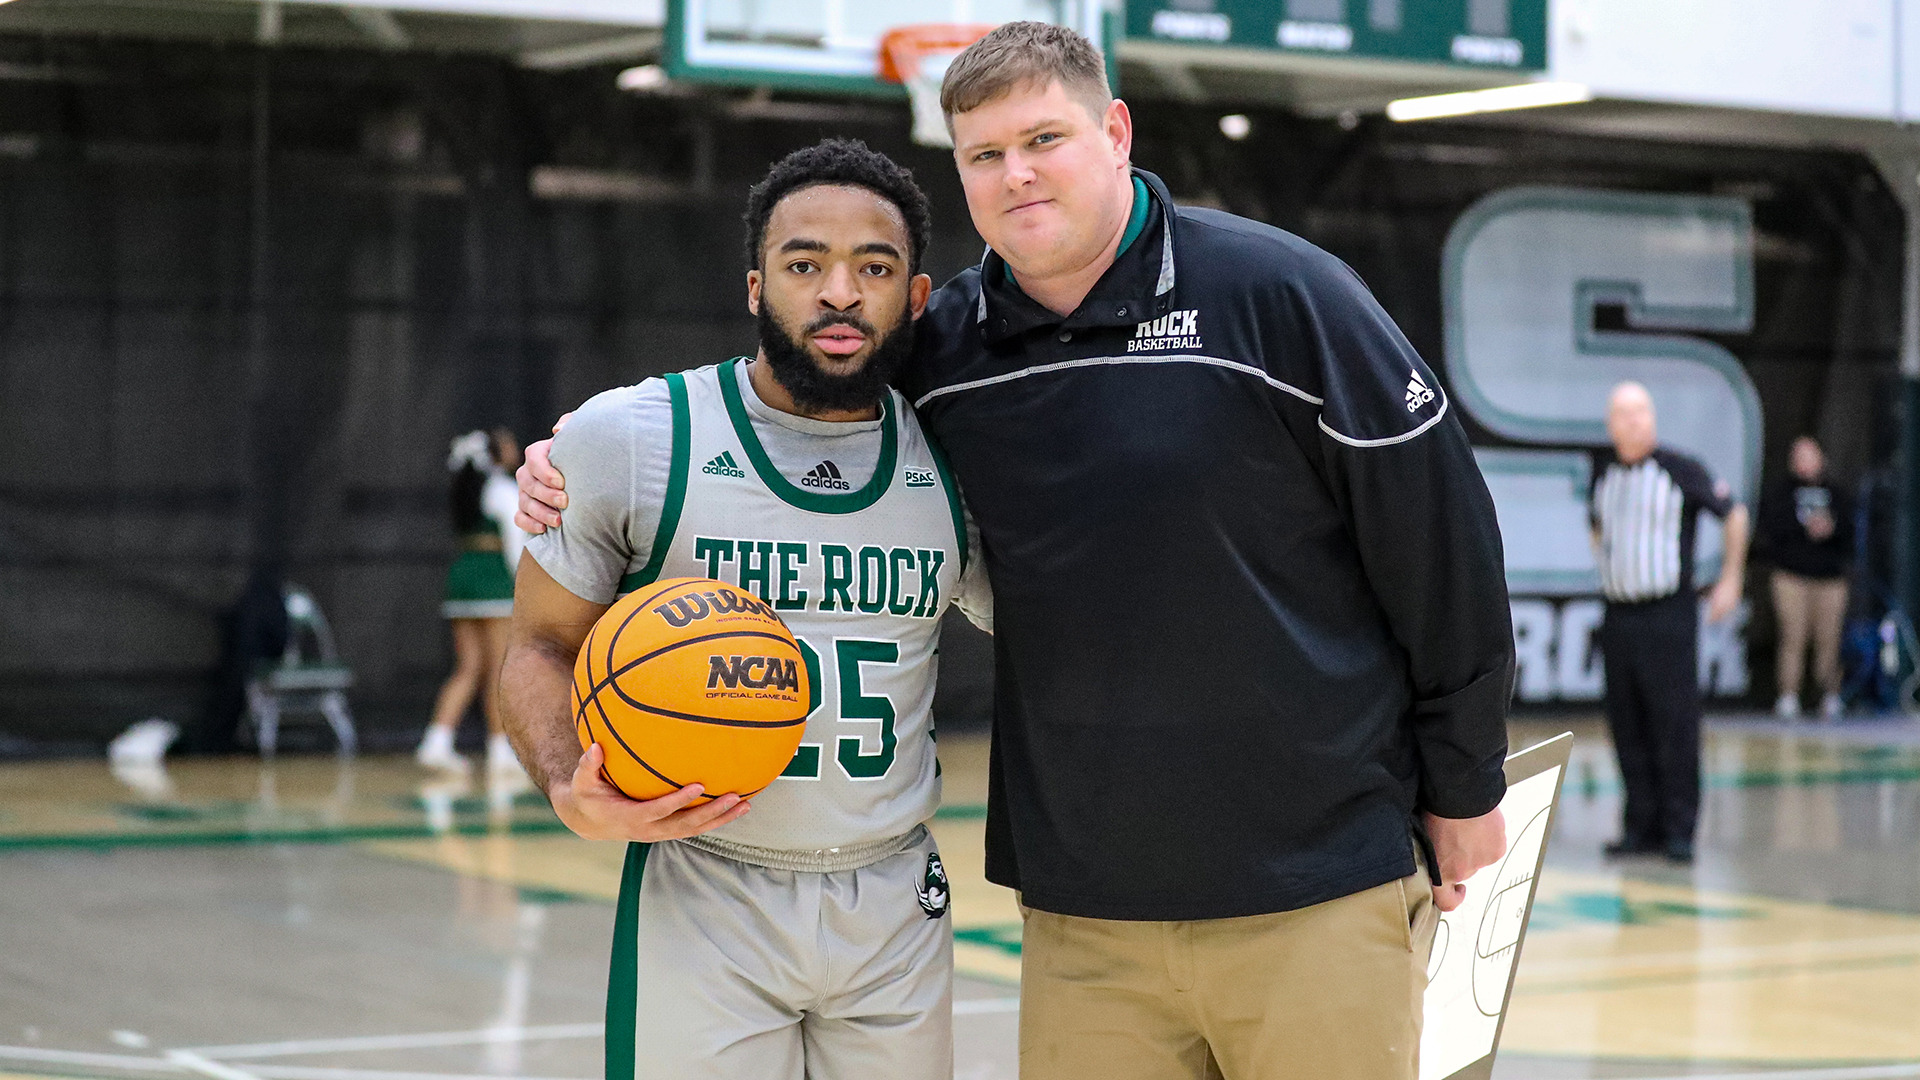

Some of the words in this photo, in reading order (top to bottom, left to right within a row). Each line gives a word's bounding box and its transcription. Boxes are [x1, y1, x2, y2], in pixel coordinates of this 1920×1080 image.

[1127, 336, 1203, 352] BASKETBALL
[1407, 388, 1435, 413] adidas
[702, 464, 745, 479] adidas
[905, 470, 935, 483] PSAC
[801, 476, 850, 491] adidas
[693, 535, 810, 613] THE
[817, 542, 946, 619] ROCK
[652, 588, 787, 629] Wilso
[706, 655, 799, 693] NCAA
[706, 692, 752, 700] OFFICIAL
[755, 692, 781, 701] GAME
[781, 694, 799, 703] BALL
